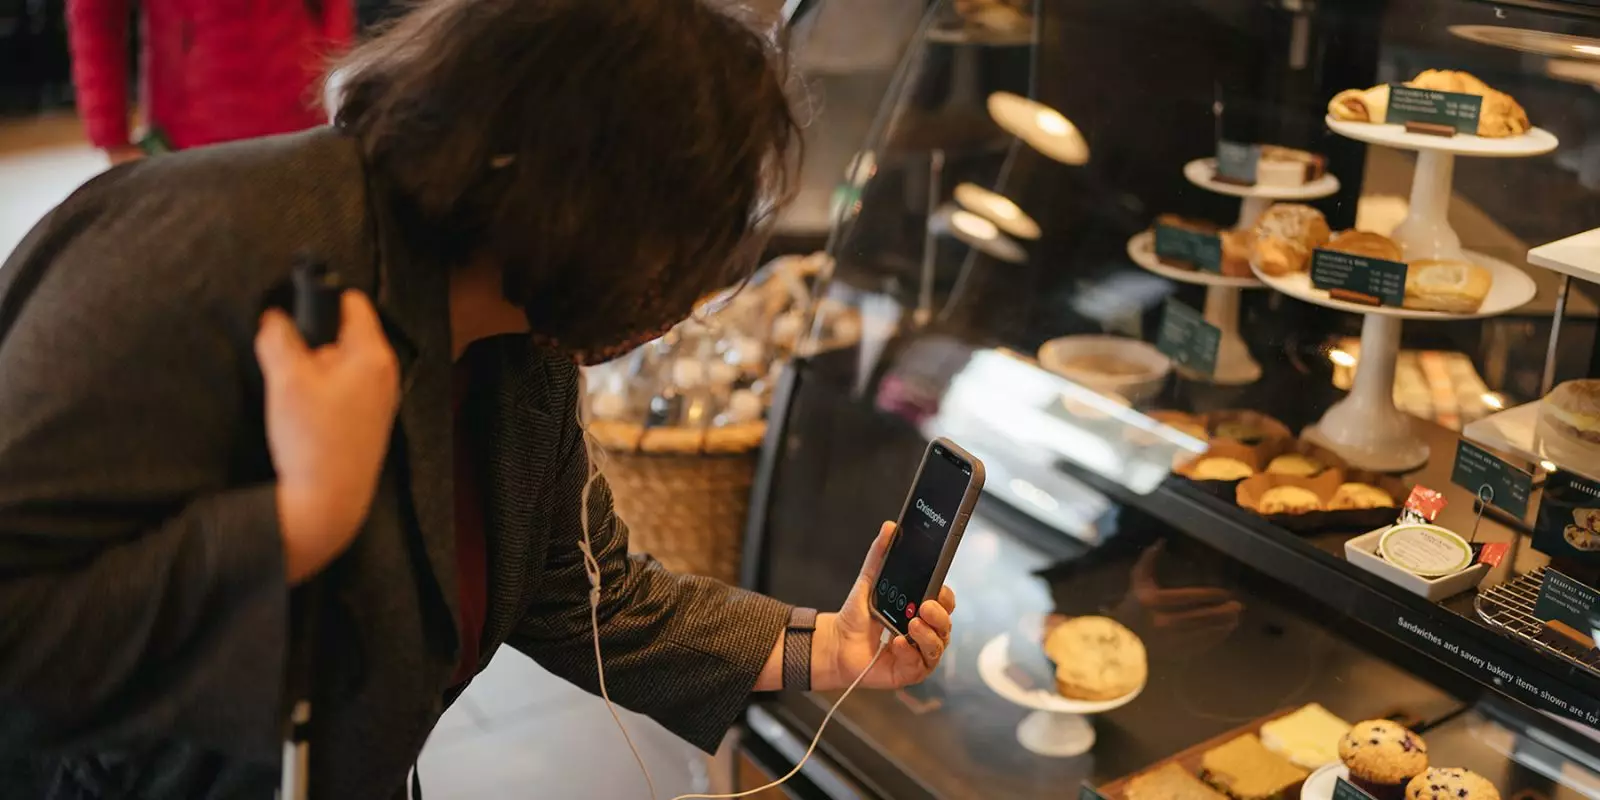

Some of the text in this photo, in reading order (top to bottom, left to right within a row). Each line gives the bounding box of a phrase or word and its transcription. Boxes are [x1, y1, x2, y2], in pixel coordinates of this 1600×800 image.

[916, 498, 947, 527] Christopher
[1550, 577, 1595, 603] BREAKFAST WRAPS
[1398, 616, 1598, 725] Sandwiches and savory bakery items shown are for
